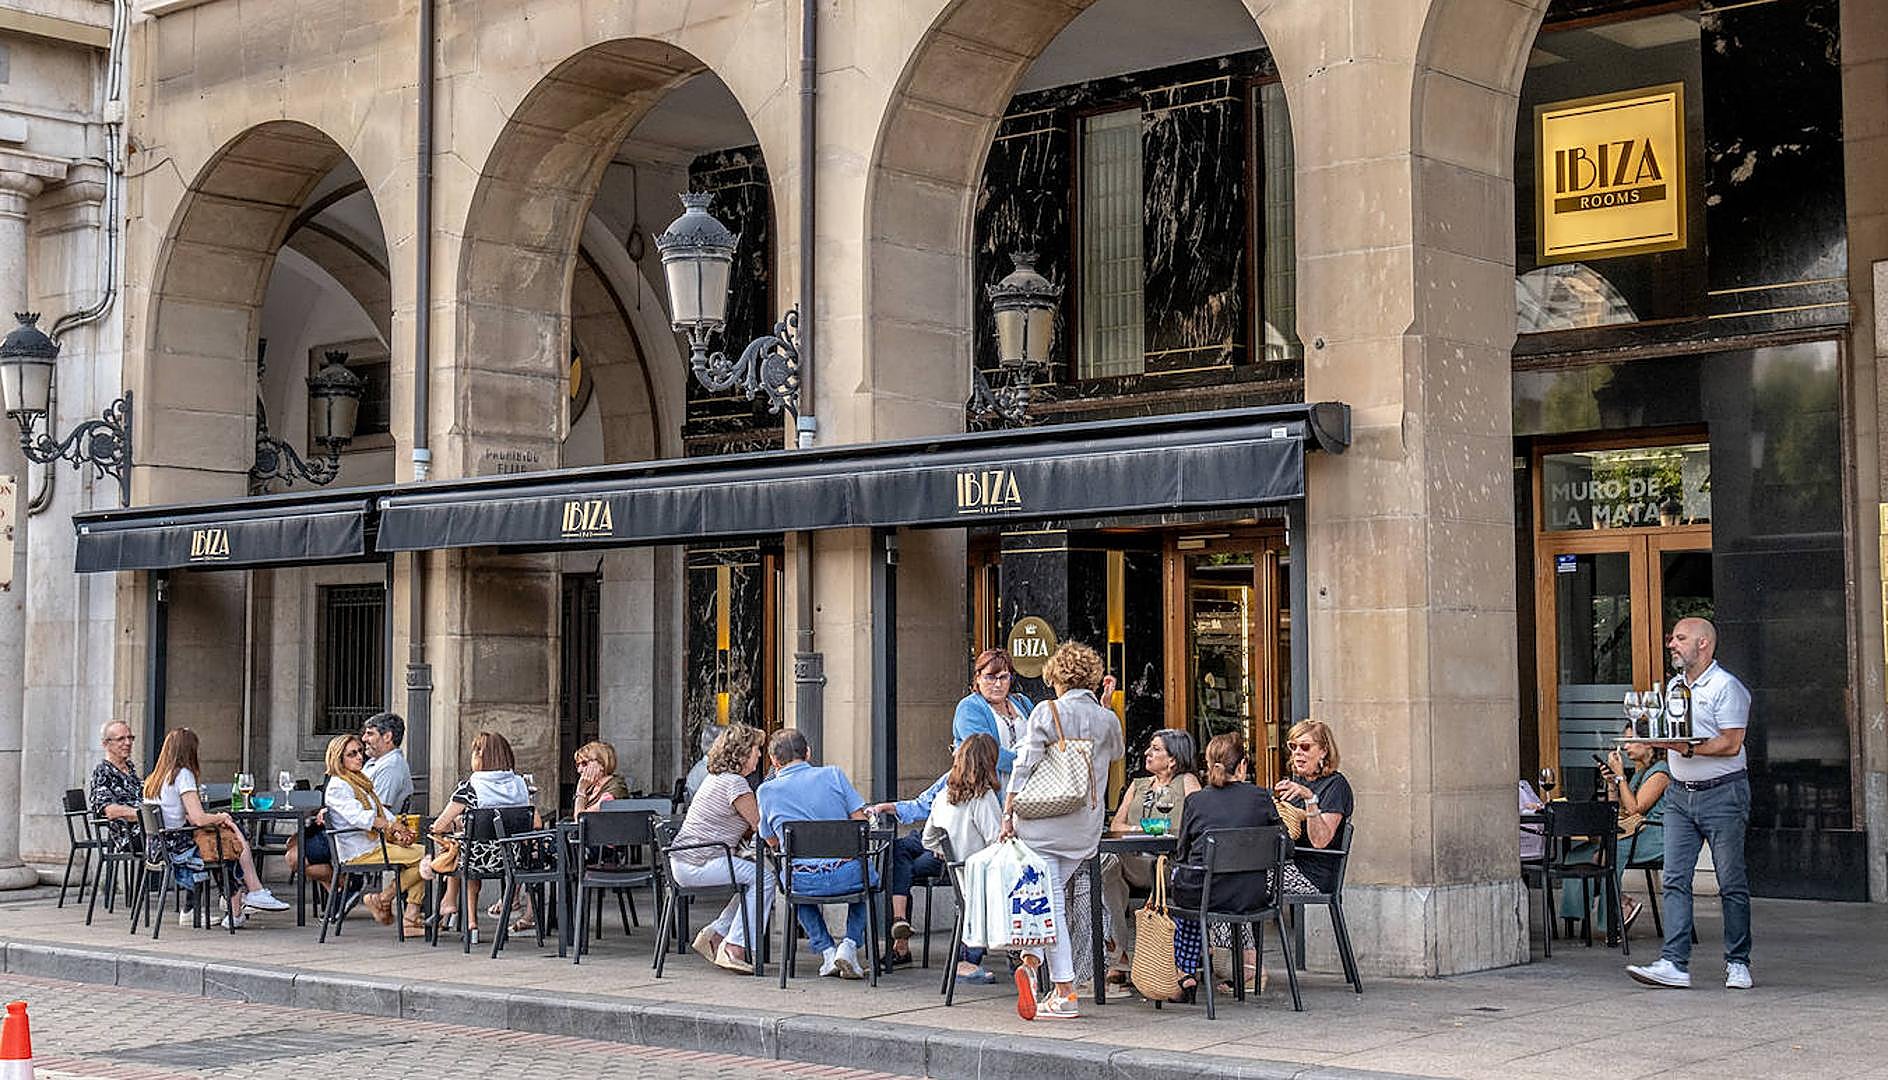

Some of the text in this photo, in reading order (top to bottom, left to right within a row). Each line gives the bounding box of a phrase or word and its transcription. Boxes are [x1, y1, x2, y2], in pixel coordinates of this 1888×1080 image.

[1555, 138, 1663, 194] IBIZA
[1580, 190, 1641, 209] ROOMS
[956, 470, 1021, 507] IBIZA
[1552, 476, 1661, 502] MURO DE
[561, 500, 613, 531] IBIZA
[1552, 501, 1661, 529] LA MATA
[191, 529, 230, 556] IBIZA
[1013, 638, 1049, 657] IBIZA
[1012, 896, 1051, 915] K2
